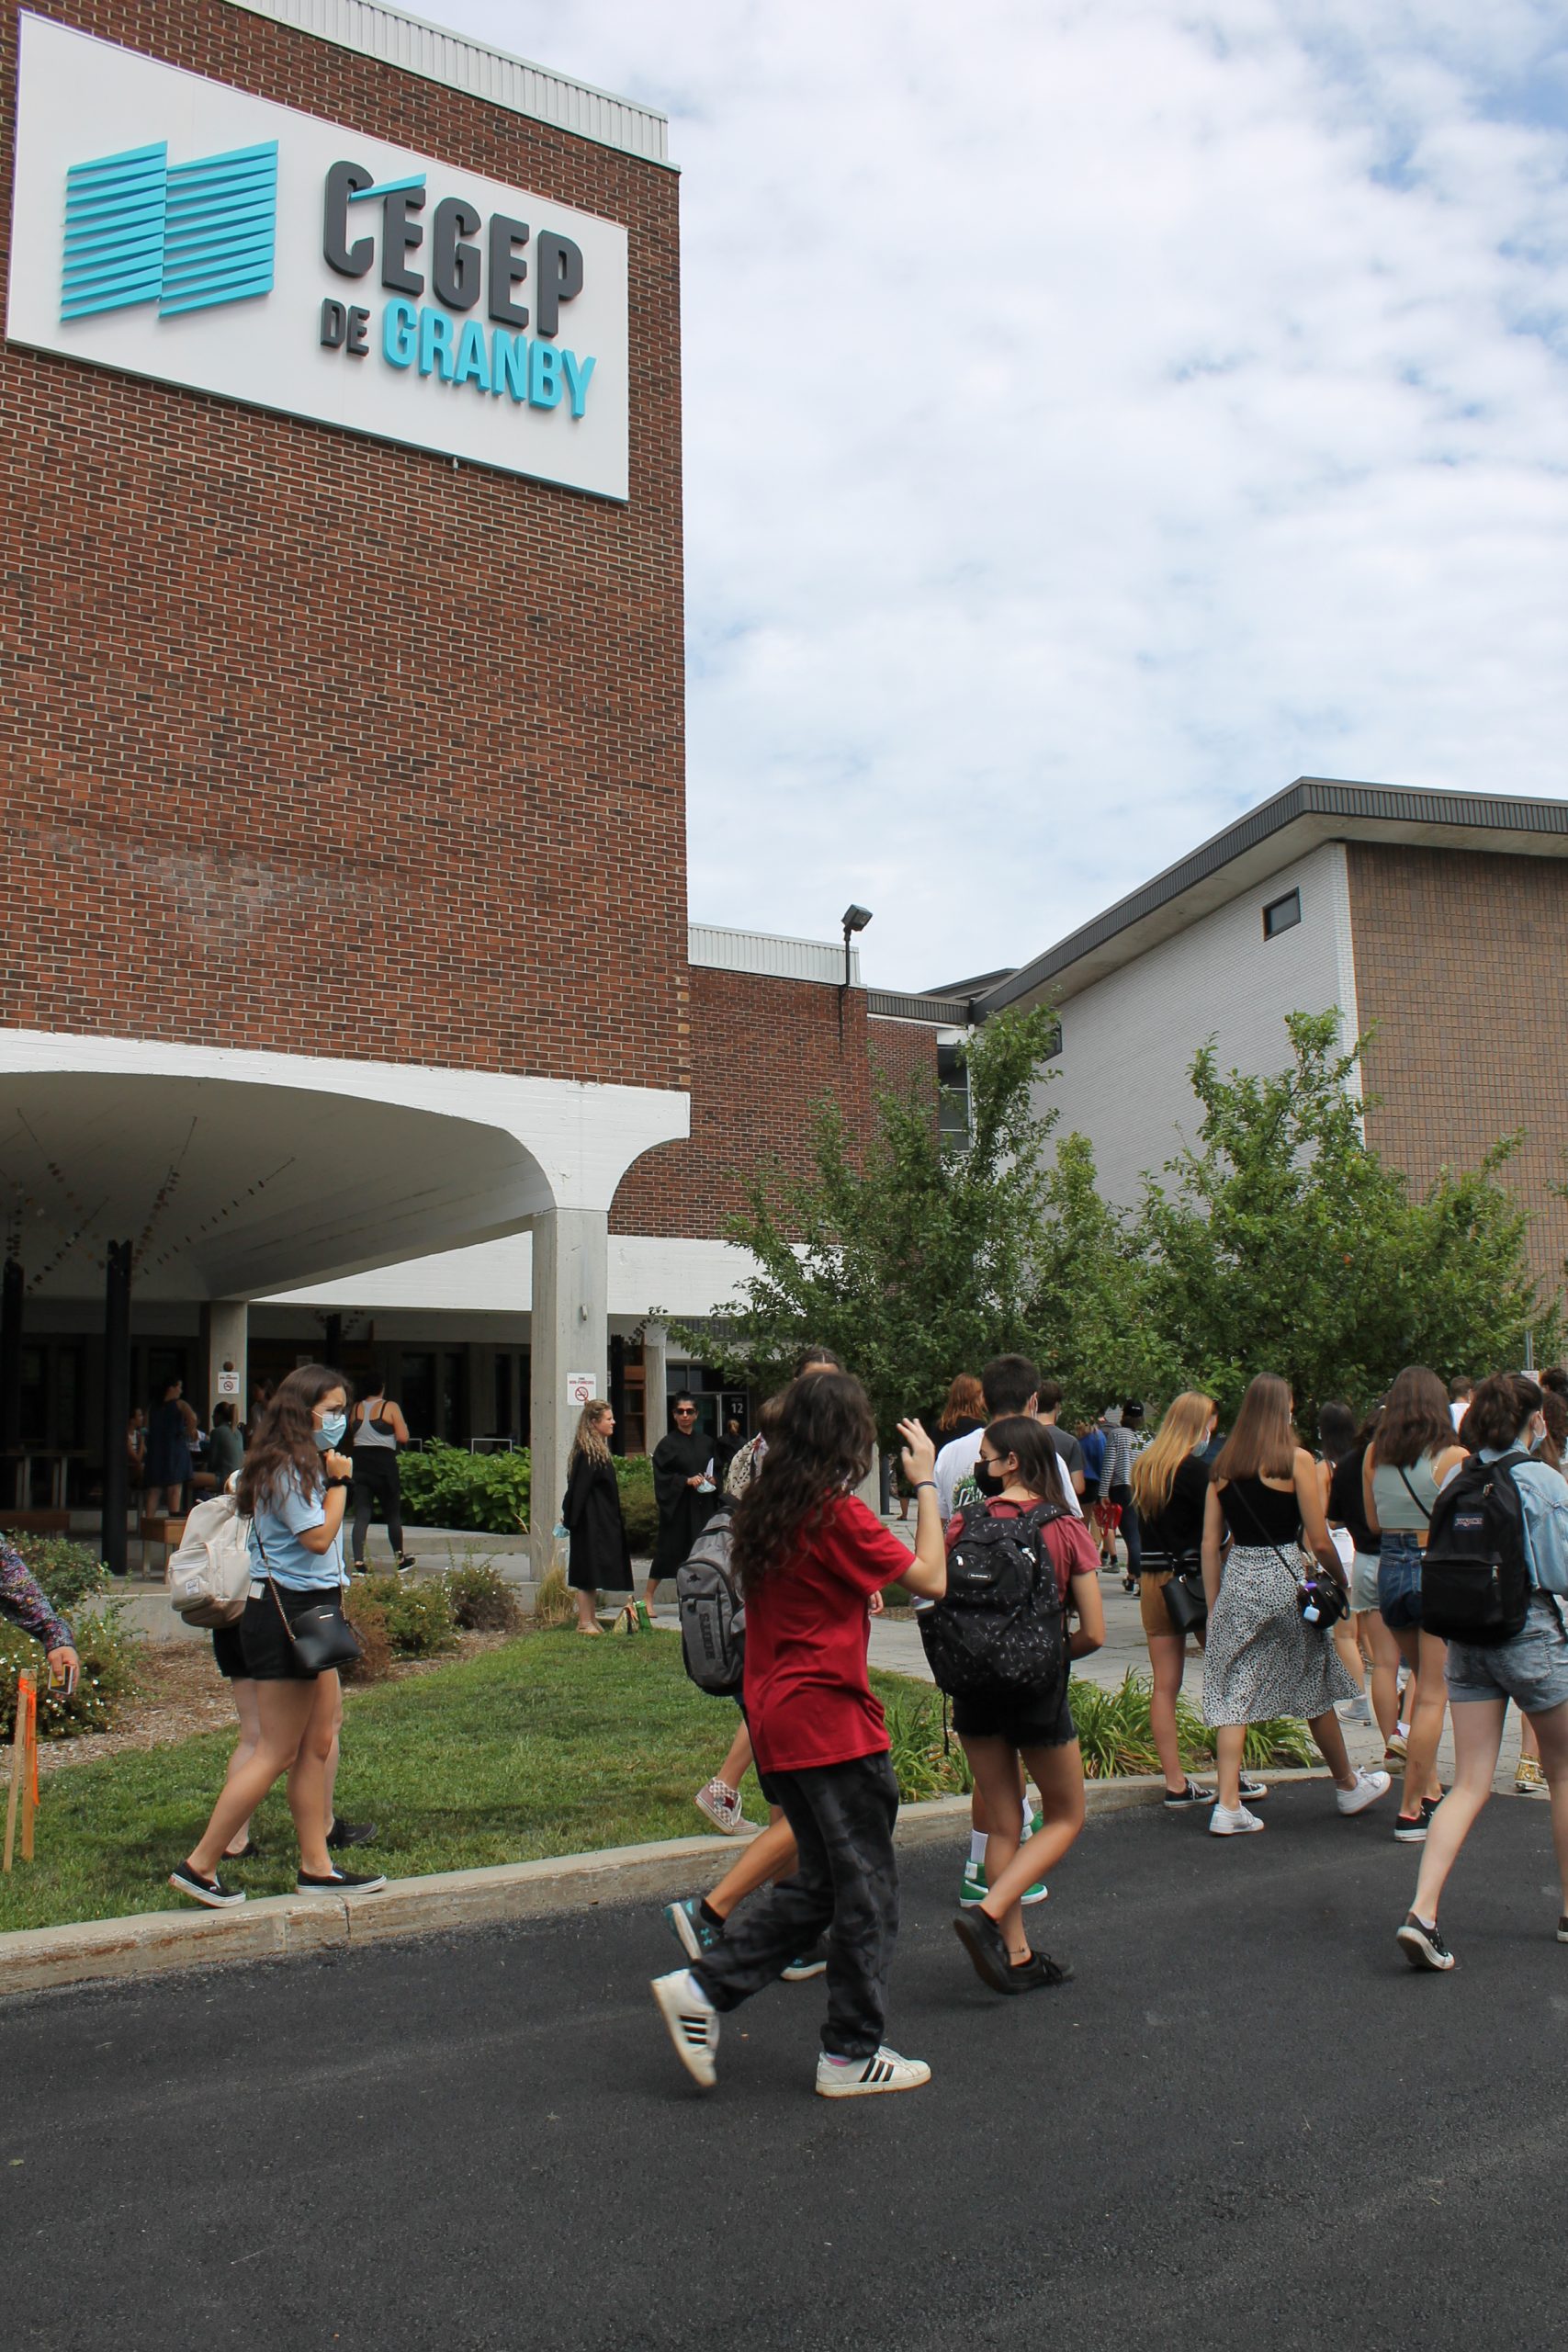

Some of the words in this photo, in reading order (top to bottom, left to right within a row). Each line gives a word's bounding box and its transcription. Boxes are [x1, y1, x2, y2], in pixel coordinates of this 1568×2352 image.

[321, 298, 370, 357] DE
[382, 298, 597, 419] GRANBY
[731, 1403, 743, 1414] 12
